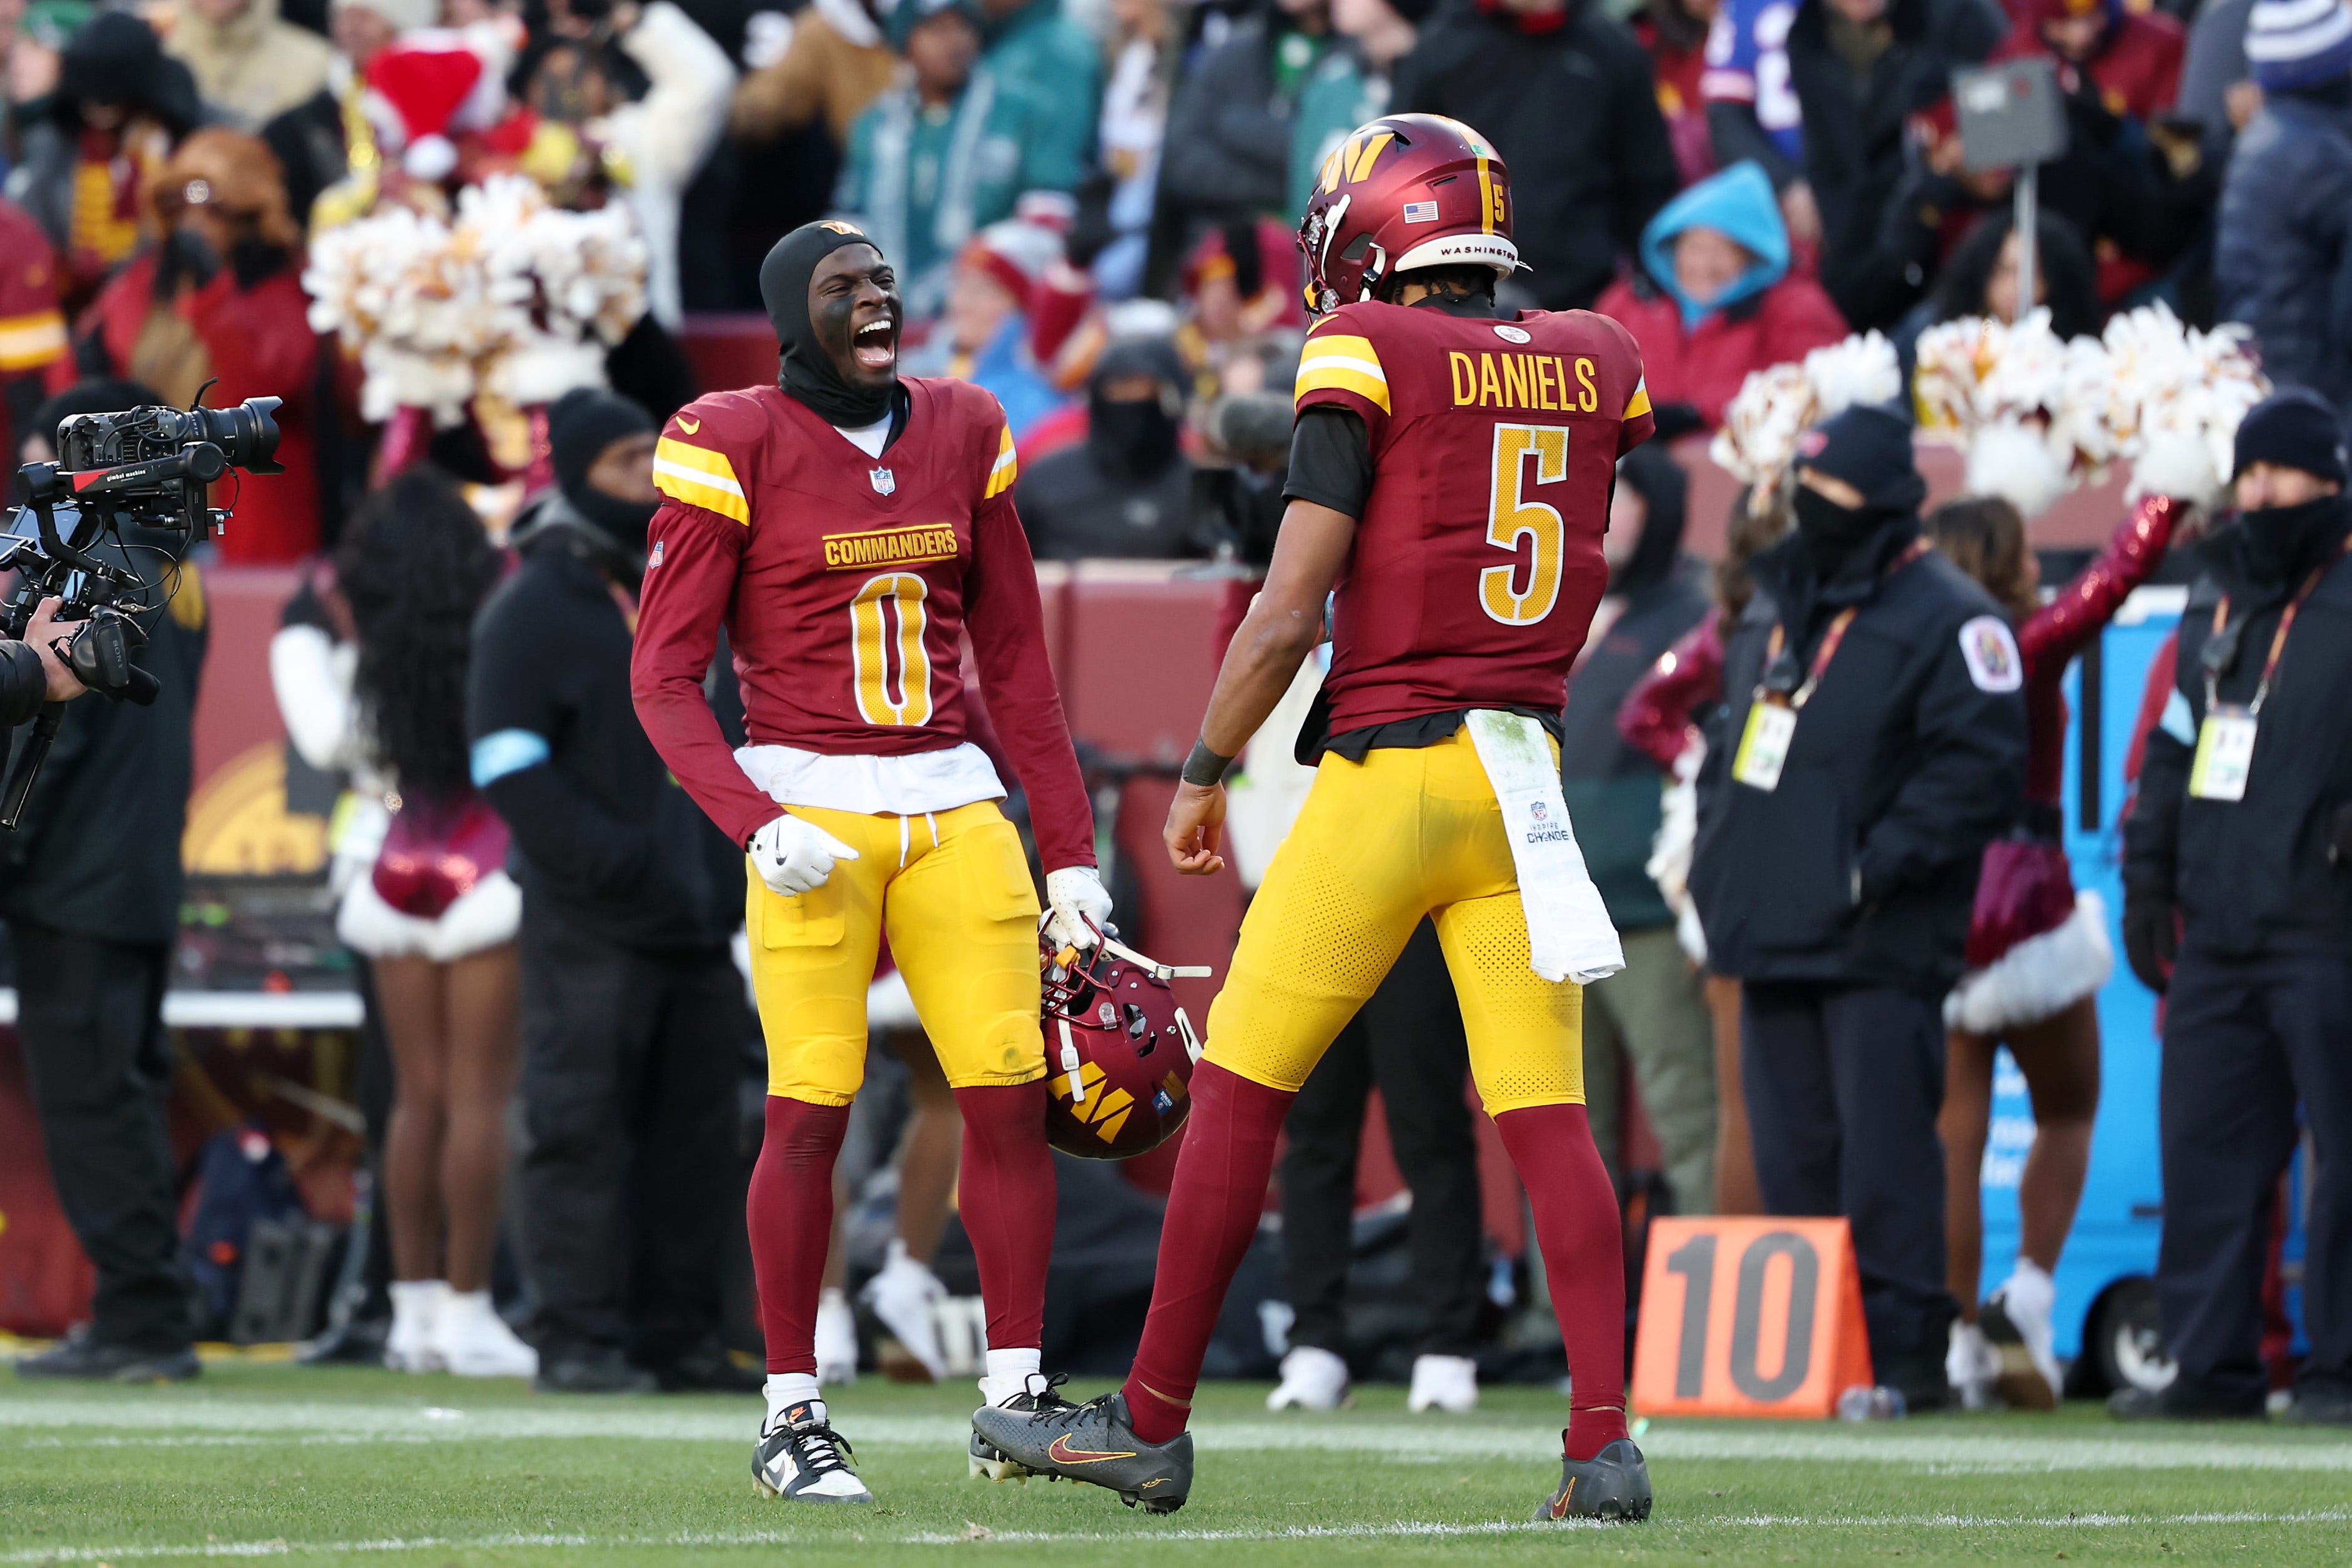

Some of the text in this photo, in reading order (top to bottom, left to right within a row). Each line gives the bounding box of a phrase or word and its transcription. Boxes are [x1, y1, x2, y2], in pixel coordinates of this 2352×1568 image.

[1493, 184, 1505, 222] 5
[1441, 246, 1515, 261] WASHINGTON
[1449, 352, 1598, 412] DANIELS
[107, 473, 124, 481] gimbal
[876, 480, 892, 491] NFL
[1478, 422, 1569, 626] 5
[825, 530, 958, 566] COMMANDERS
[850, 572, 933, 726] 0
[1527, 831, 1569, 843] CHANGE
[1667, 1230, 1821, 1403] 10
